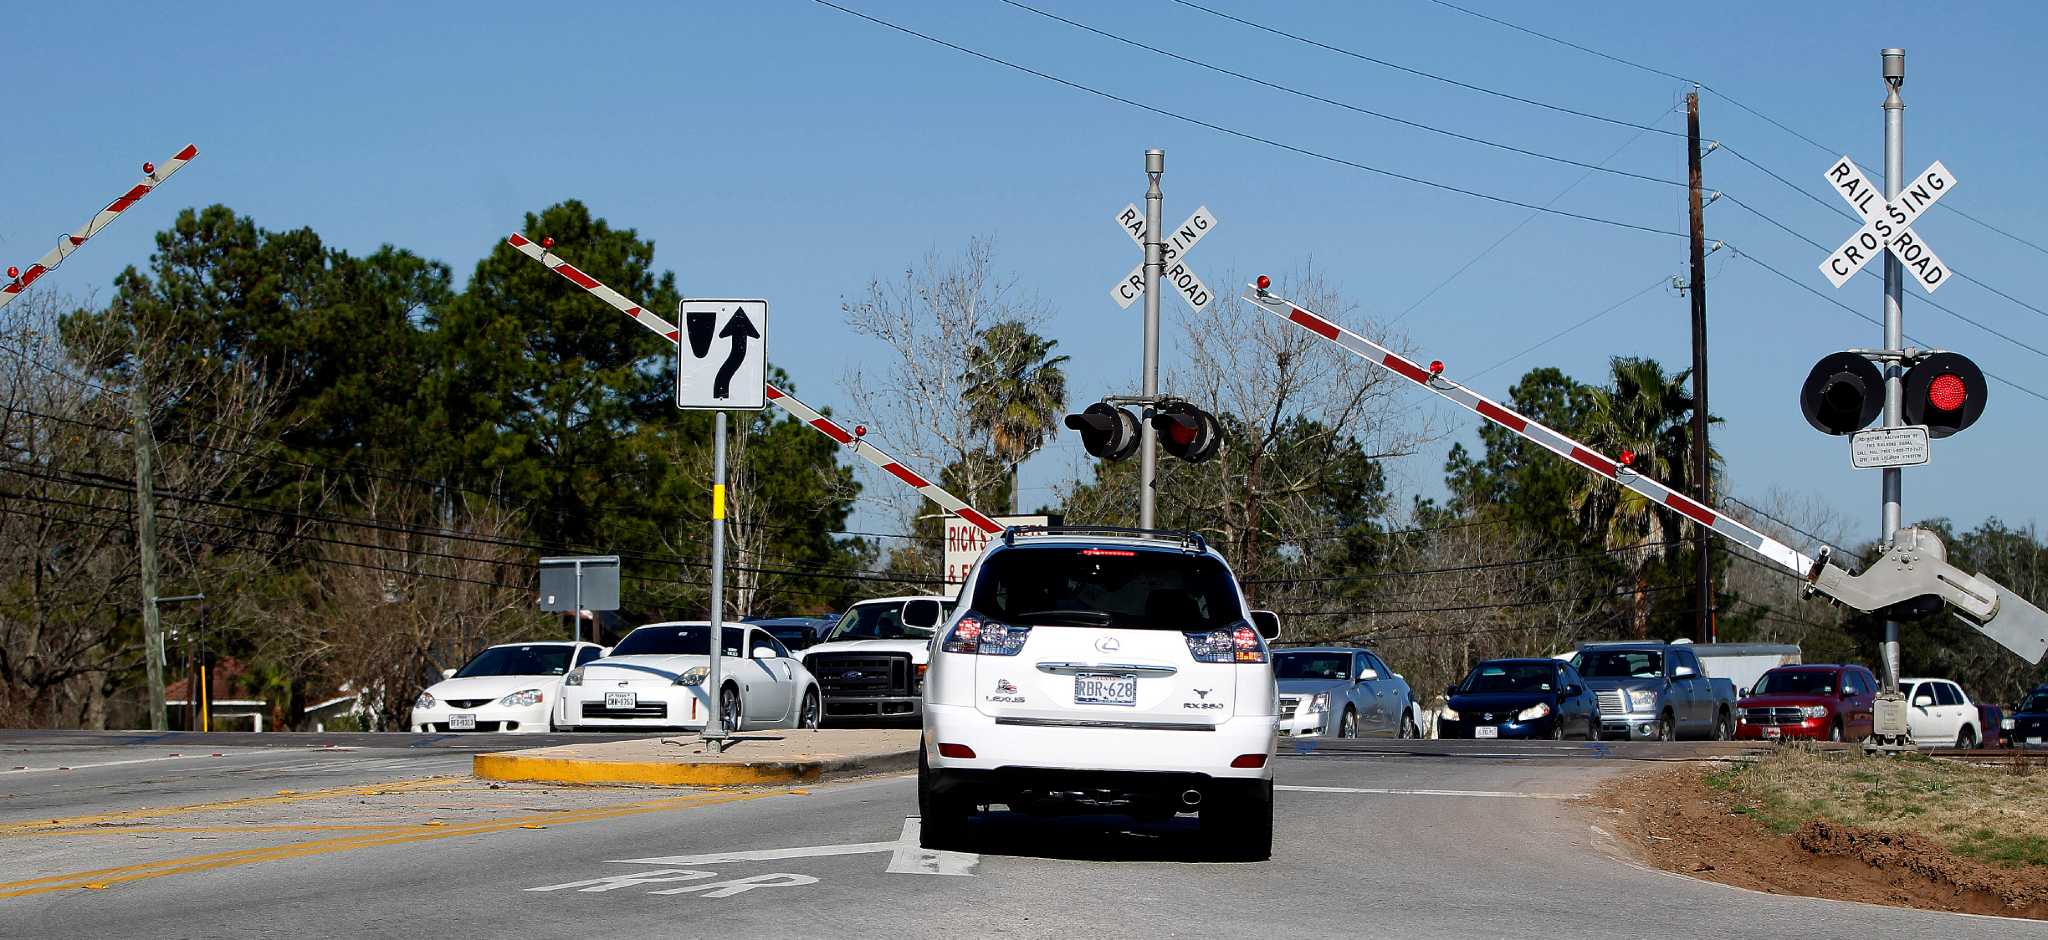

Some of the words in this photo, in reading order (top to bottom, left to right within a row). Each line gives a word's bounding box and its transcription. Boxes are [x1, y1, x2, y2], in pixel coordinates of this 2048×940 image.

[1831, 162, 1874, 214] RAIL
[1893, 232, 1943, 285] ROAD
[1831, 172, 1944, 276] CROSSING
[1169, 264, 1208, 306] ROAD
